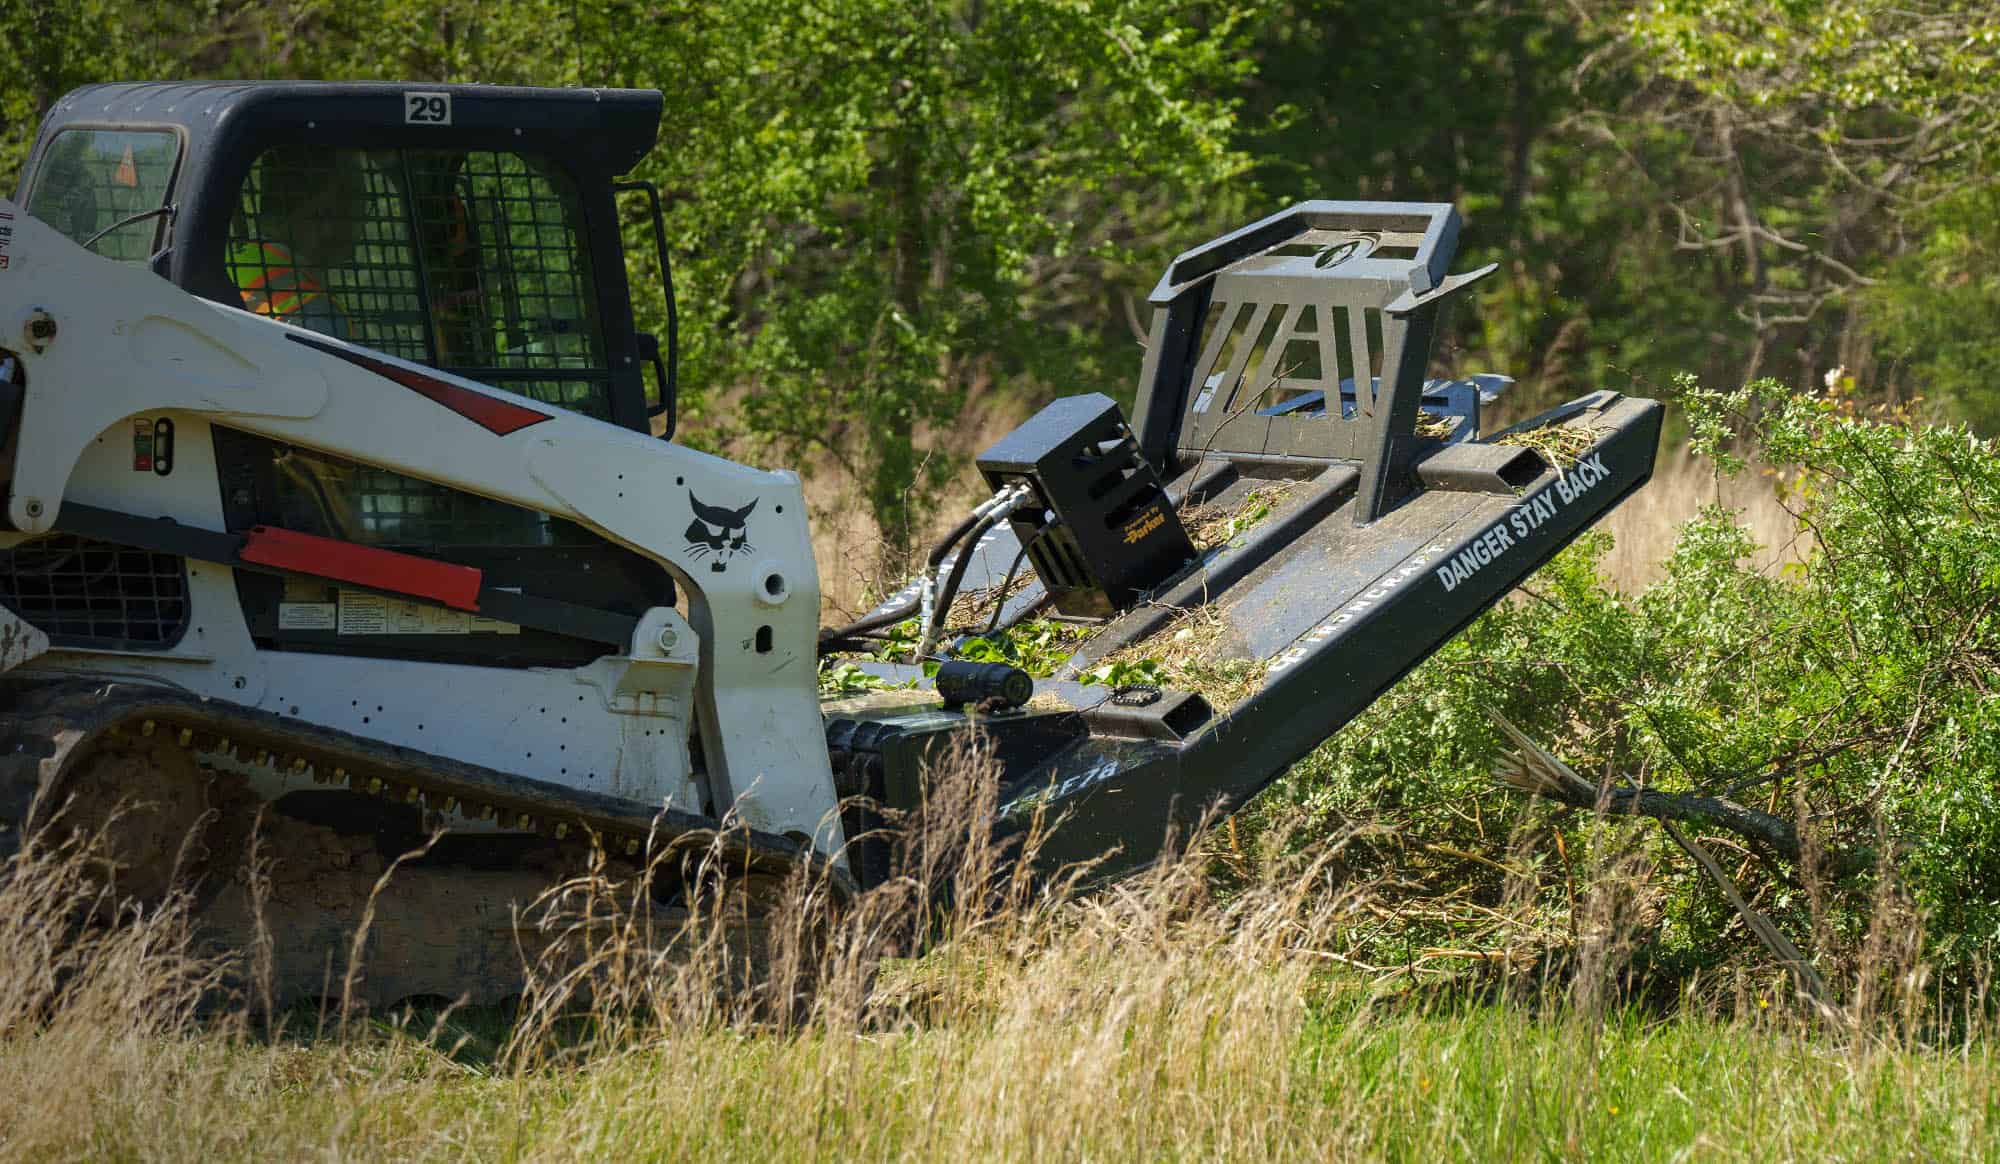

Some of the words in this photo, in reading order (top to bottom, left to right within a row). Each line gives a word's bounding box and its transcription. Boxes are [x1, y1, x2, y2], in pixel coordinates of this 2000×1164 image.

[410, 97, 446, 122] 29
[1436, 523, 1515, 592] DANGER
[1510, 488, 1558, 538] STAY
[1554, 452, 1610, 505] BACK
